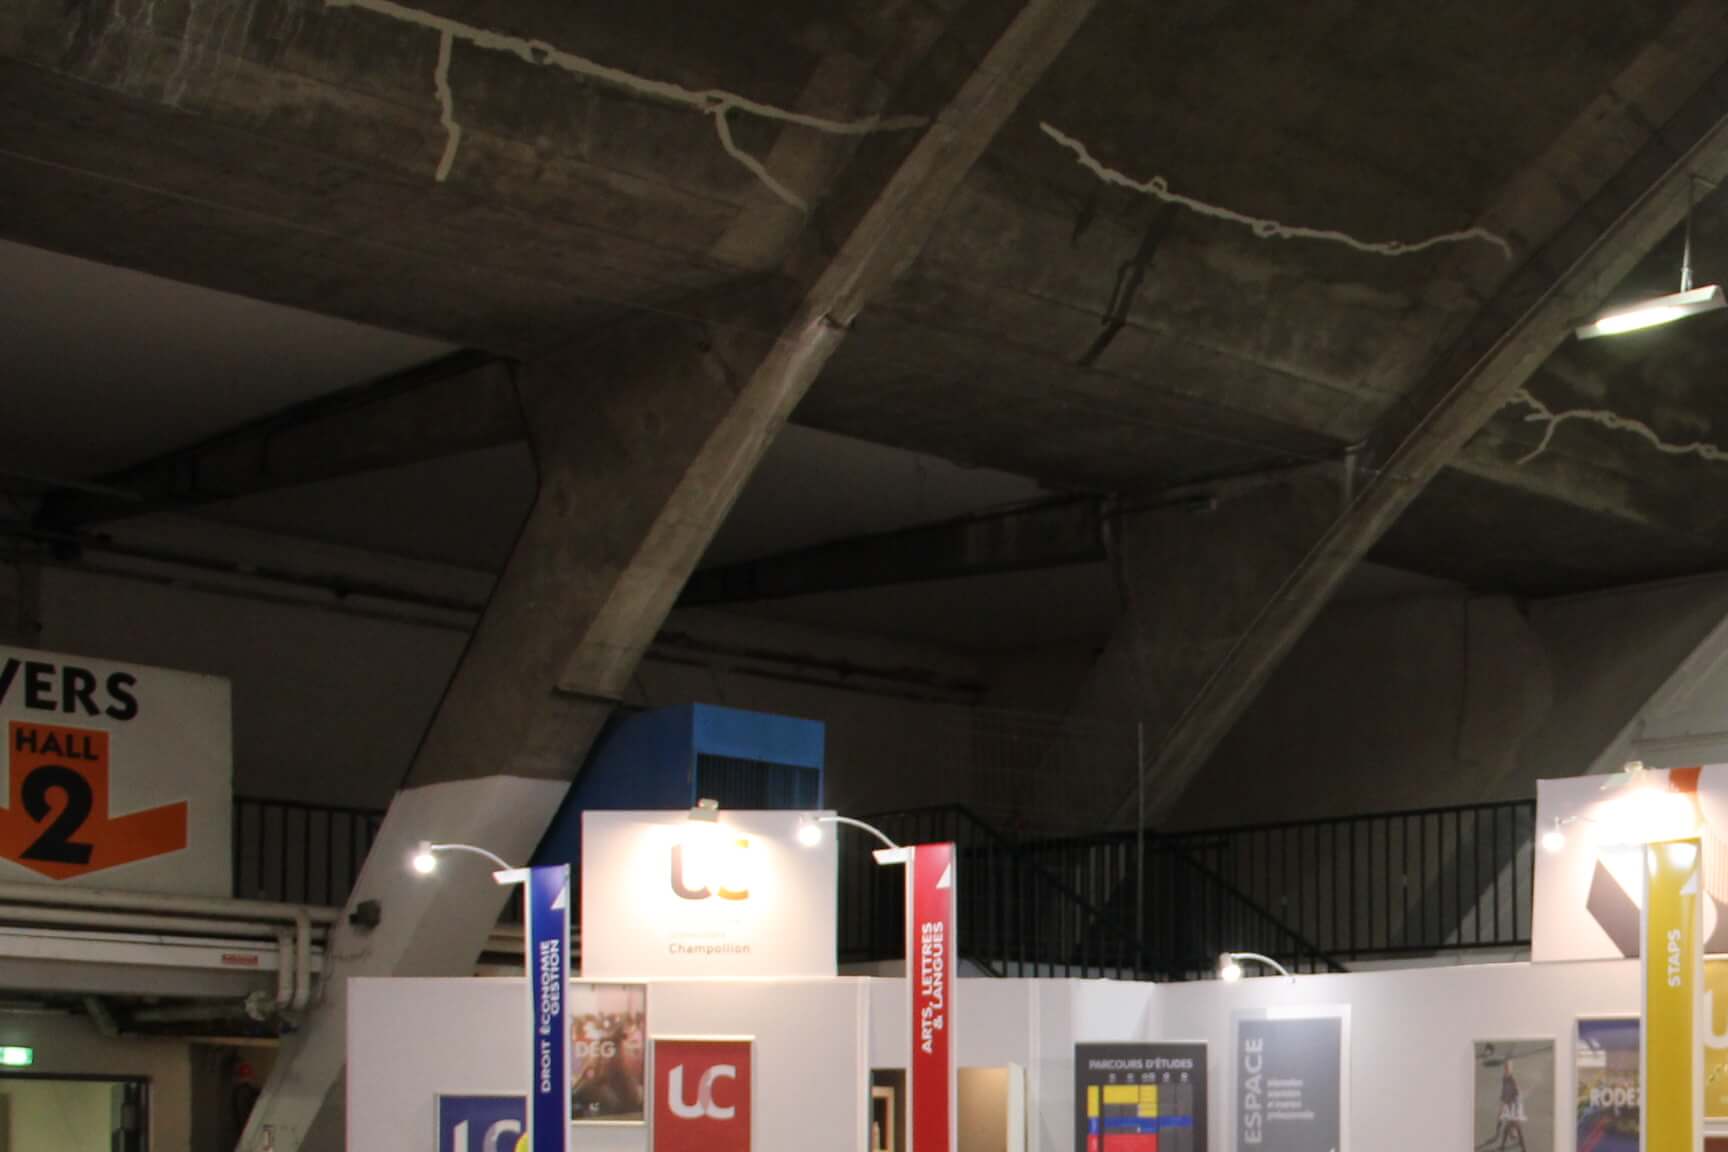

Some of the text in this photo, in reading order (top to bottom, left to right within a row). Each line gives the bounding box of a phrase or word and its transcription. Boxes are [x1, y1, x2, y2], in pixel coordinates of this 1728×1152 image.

[15, 727, 98, 760] HALL
[19, 765, 94, 864] 2
[550, 938, 560, 1015] GESTION
[669, 943, 750, 956] Champollion
[921, 922, 932, 996] LETTRES
[933, 921, 944, 1029] & LANGUES
[1667, 928, 1681, 987] STAPS
[541, 1040, 551, 1094] DROIT
[668, 1064, 736, 1119] UC
[1089, 1058, 1143, 1070] PARCOURS
[1245, 1038, 1263, 1144] ESPACE
[1590, 1086, 1640, 1108] RODE
